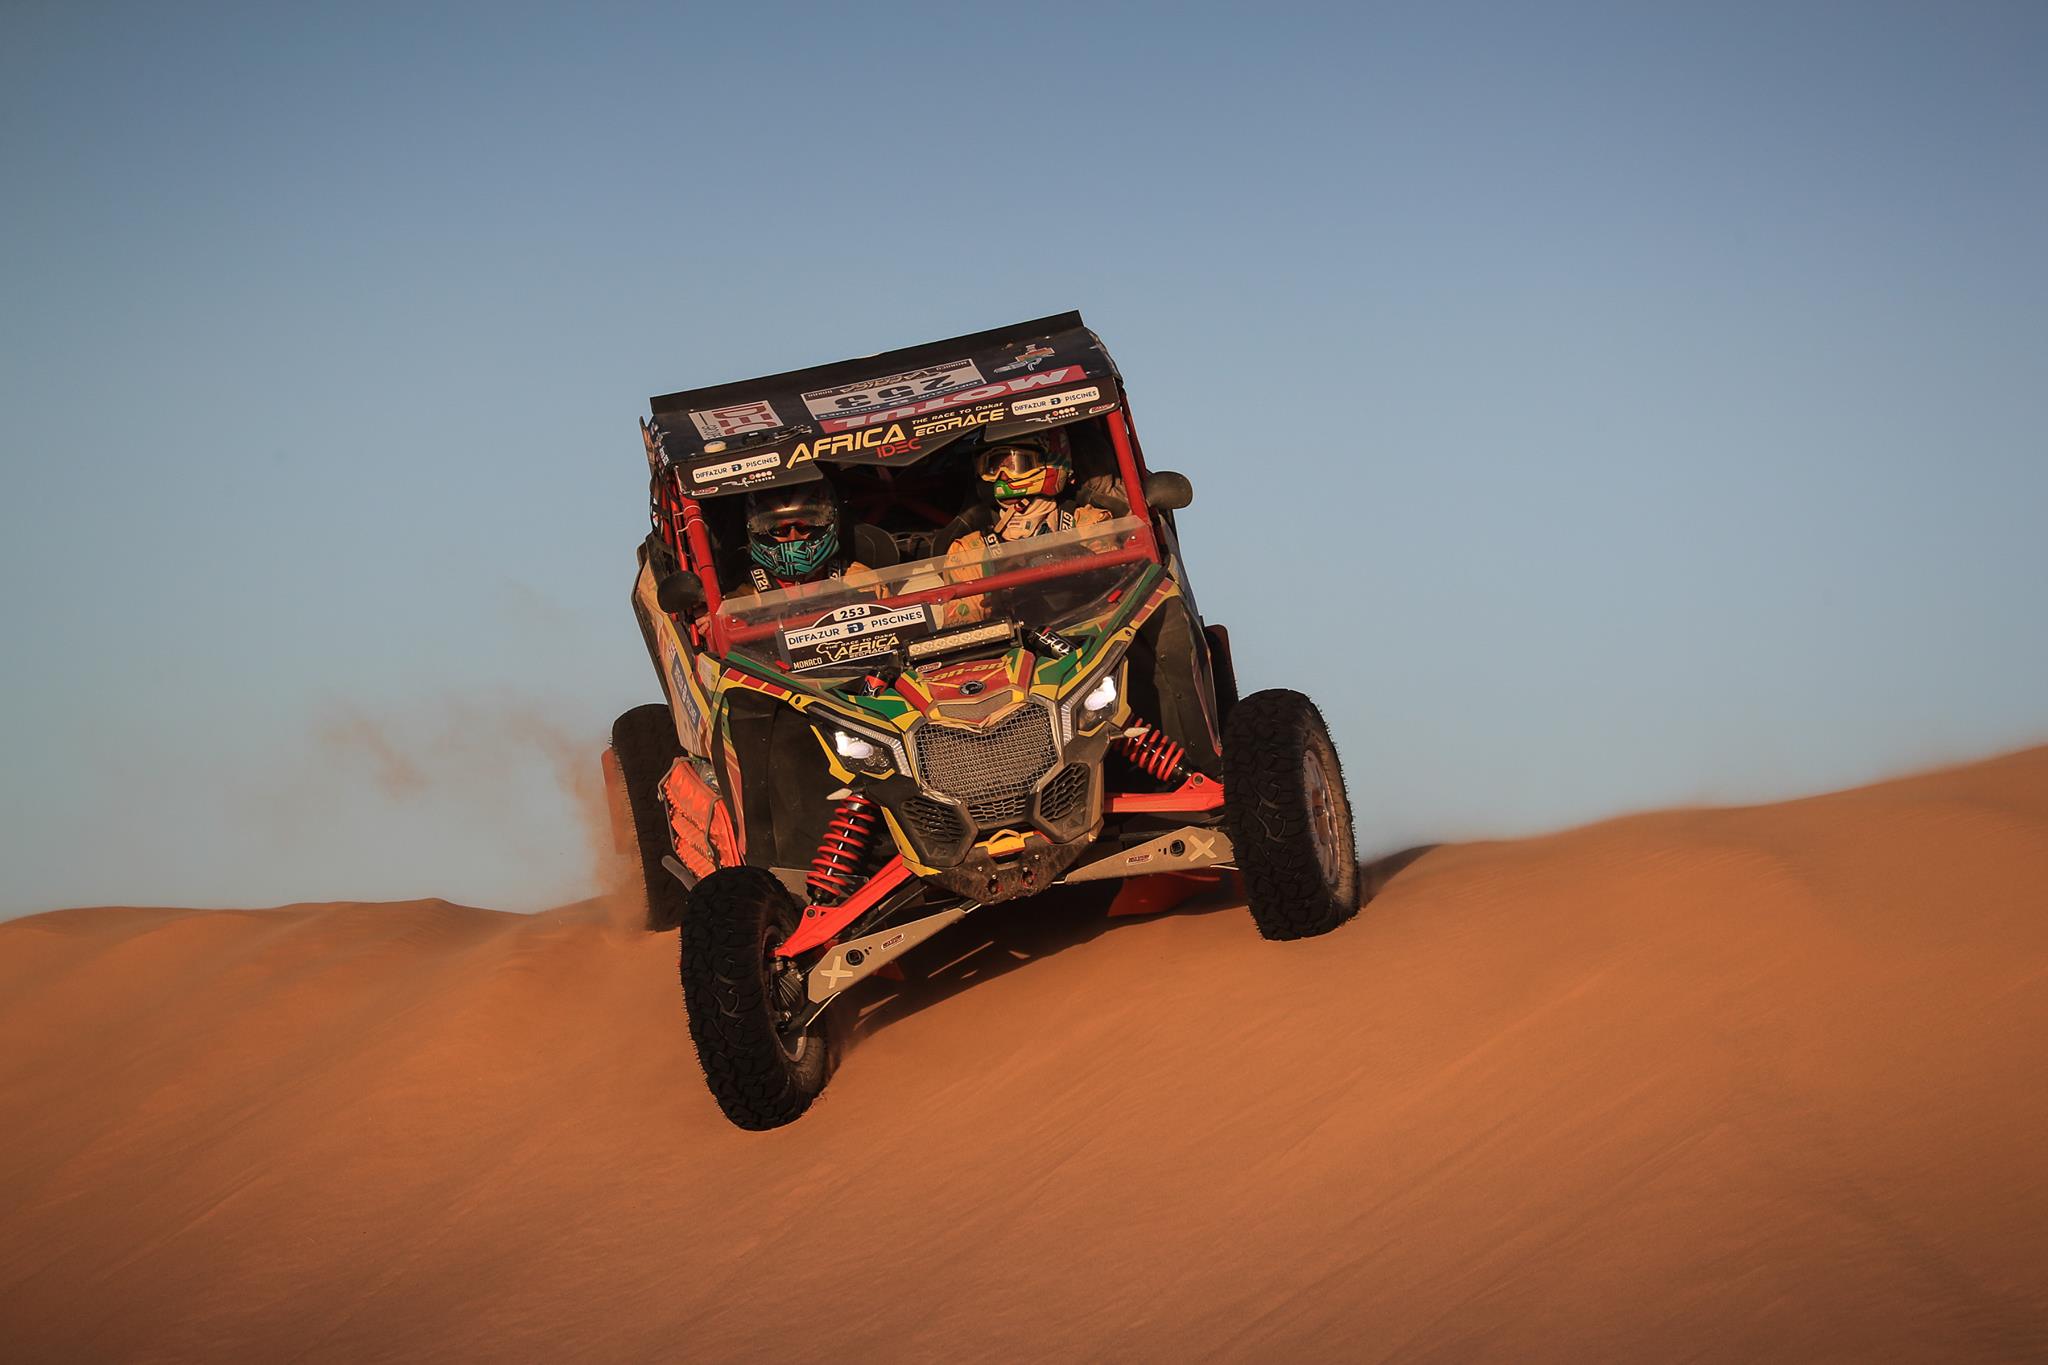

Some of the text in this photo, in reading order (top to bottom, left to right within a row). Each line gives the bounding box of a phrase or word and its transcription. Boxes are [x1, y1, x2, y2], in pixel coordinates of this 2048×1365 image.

[833, 368, 1069, 428] MOTUL
[834, 375, 955, 409] 253
[1014, 390, 1097, 411] DIFFAZUR PISCINES
[912, 417, 928, 425] THE
[932, 411, 956, 420] RACE
[786, 423, 906, 469] AFRICA
[695, 456, 778, 479] DIFFAZUR PISCINES
[840, 607, 865, 619] 253
[788, 611, 923, 646] DIFFAZUR PISCINES
[834, 636, 900, 659] AFRICA
[793, 657, 823, 670] MONACO
